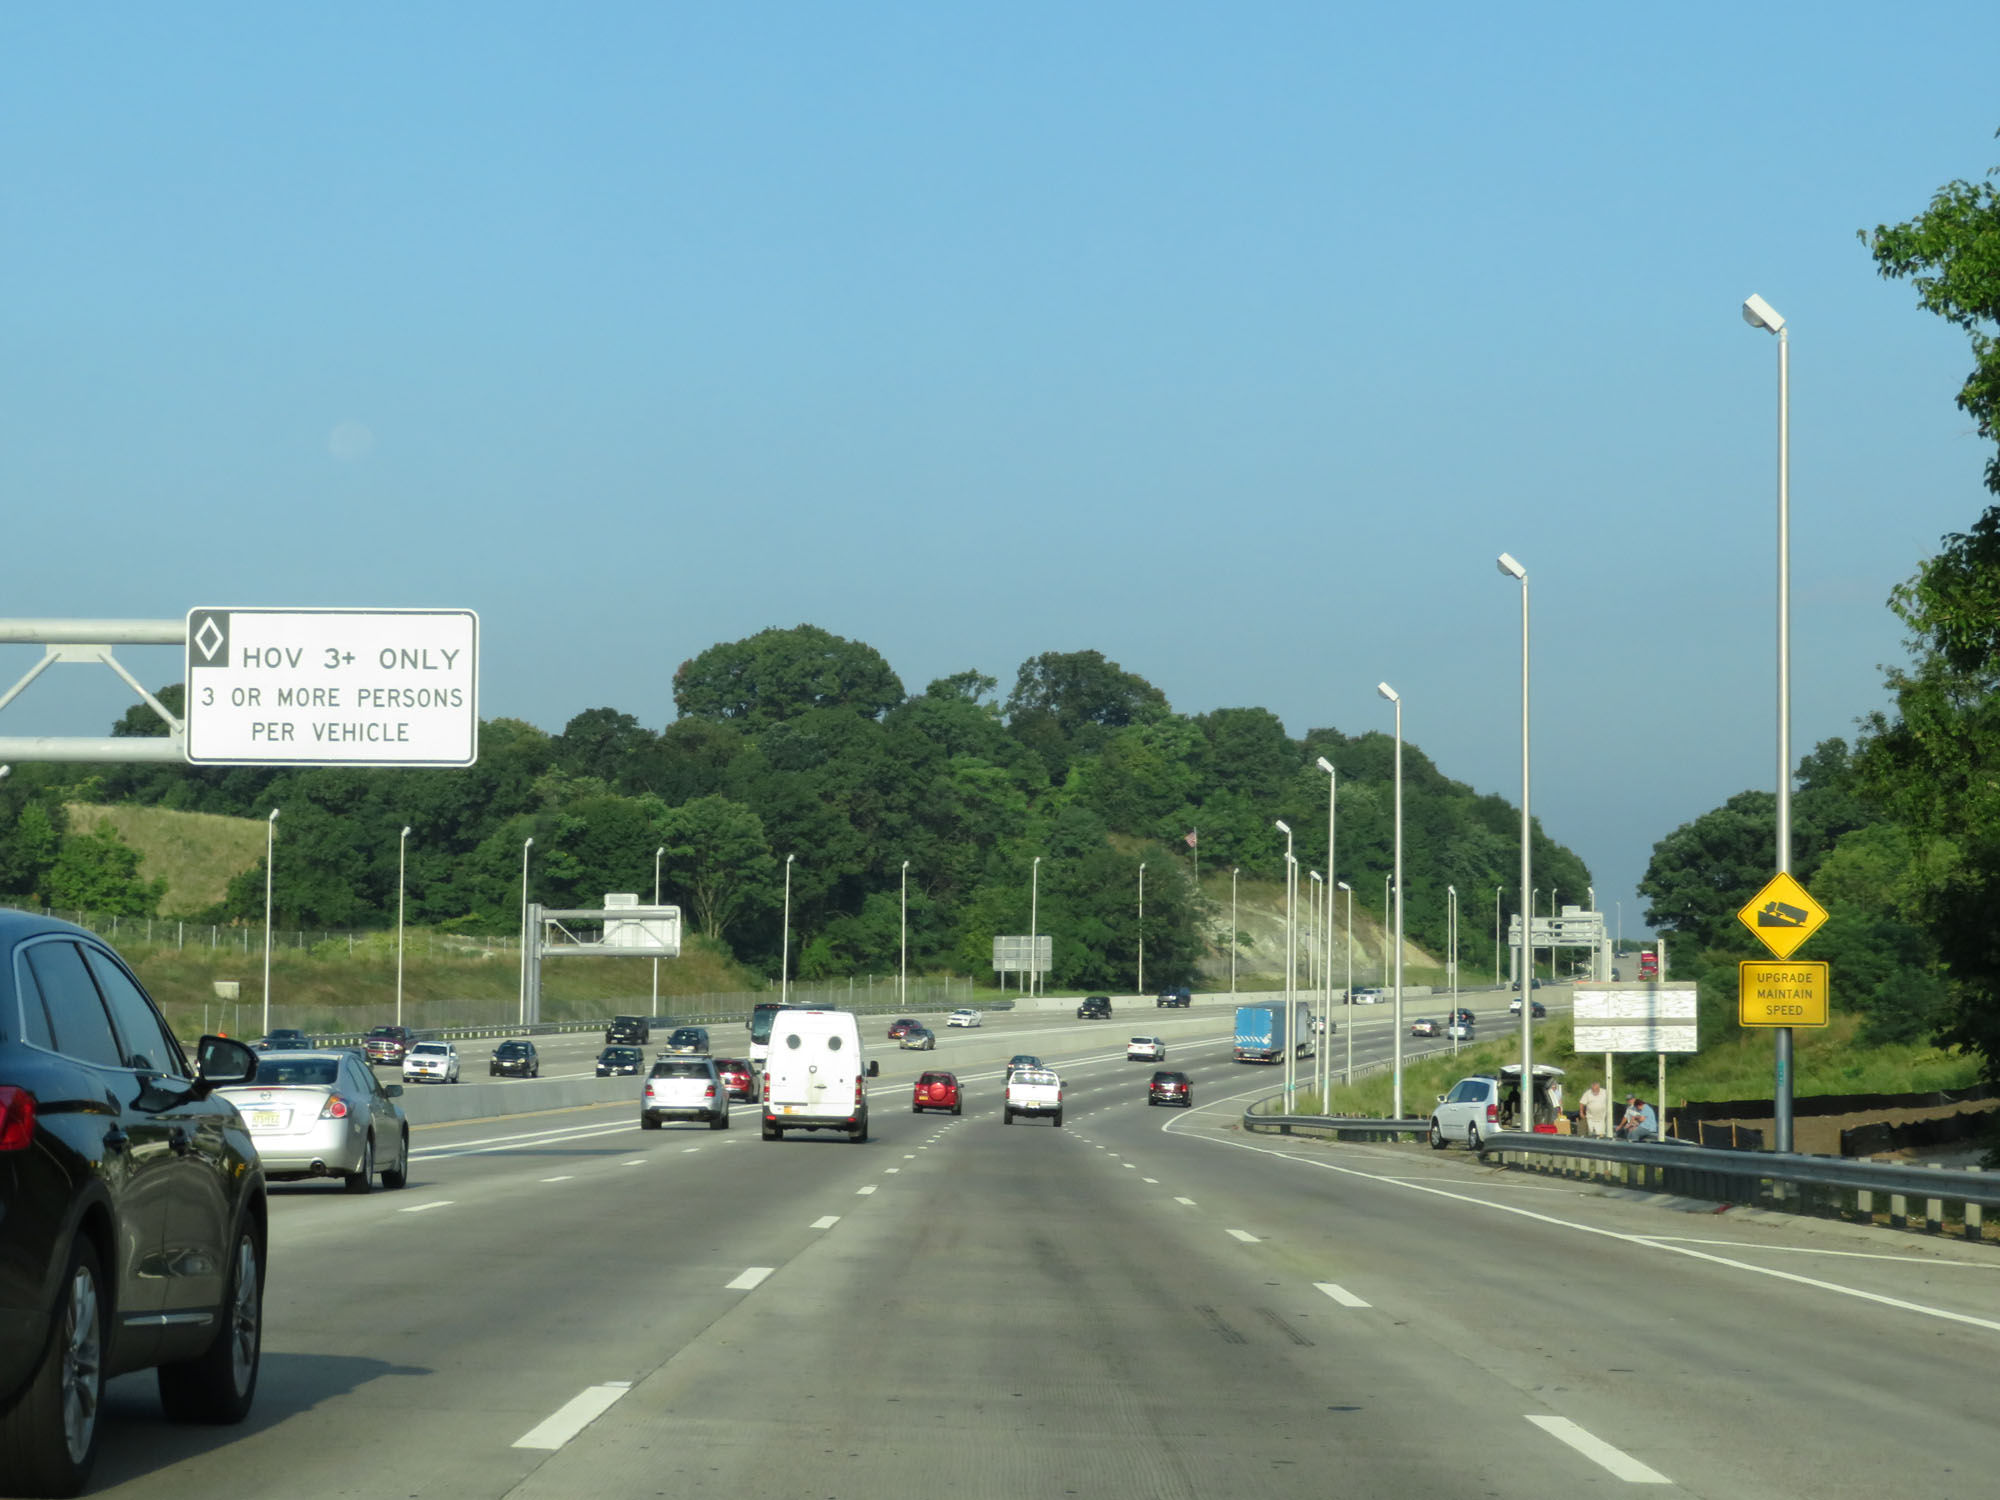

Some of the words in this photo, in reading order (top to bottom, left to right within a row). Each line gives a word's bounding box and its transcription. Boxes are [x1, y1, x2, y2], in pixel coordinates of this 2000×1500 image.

[243, 647, 303, 669] HOV
[323, 648, 356, 669] 3+
[379, 648, 460, 670] ONLY
[201, 687, 215, 706] 3
[231, 687, 262, 706] OR
[277, 687, 341, 706] MORE
[357, 688, 464, 708] PERSONS
[252, 722, 295, 741] PER
[312, 722, 410, 742] VEHICLE
[1757, 973, 1813, 983] UPGRADE
[1757, 989, 1813, 999] MAINTAIN
[1766, 1005, 1803, 1016] SPEED
